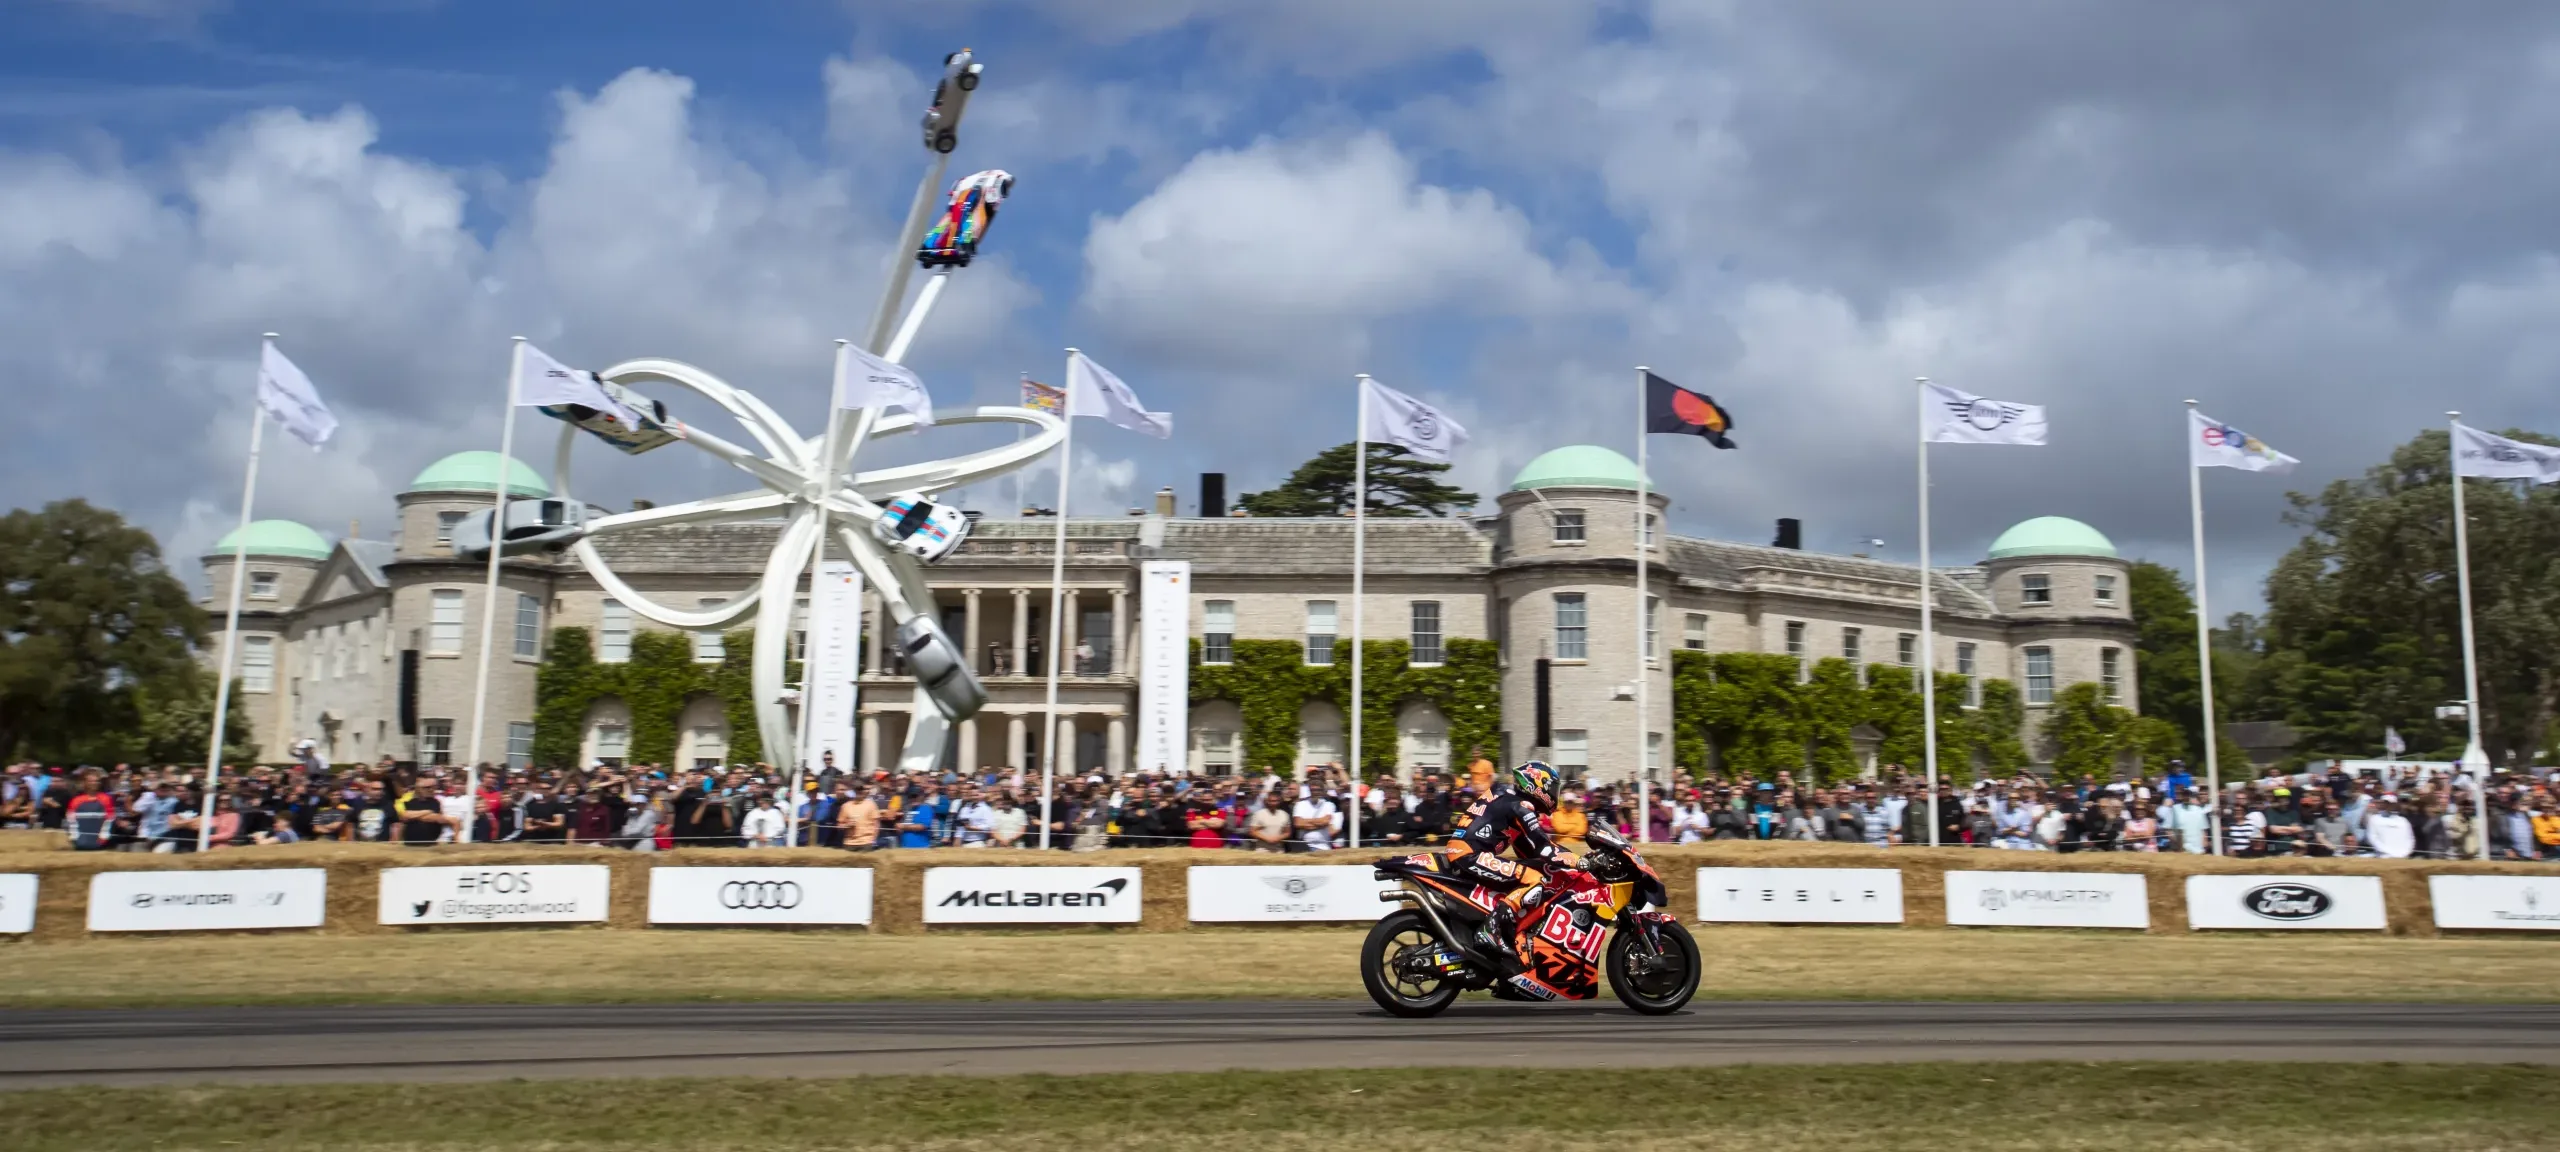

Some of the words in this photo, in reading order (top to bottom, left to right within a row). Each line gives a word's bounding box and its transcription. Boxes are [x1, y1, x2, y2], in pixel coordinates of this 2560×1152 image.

[1476, 851, 1516, 877] Red
[457, 872, 532, 894] #FOS
[442, 898, 577, 918] @fosgoodwood
[937, 890, 1107, 907] McLaren
[1265, 903, 1327, 913] BENTLEY
[2257, 888, 2319, 913] Ford
[1540, 904, 1607, 963] Bull
[1520, 978, 1547, 997] Mobil
